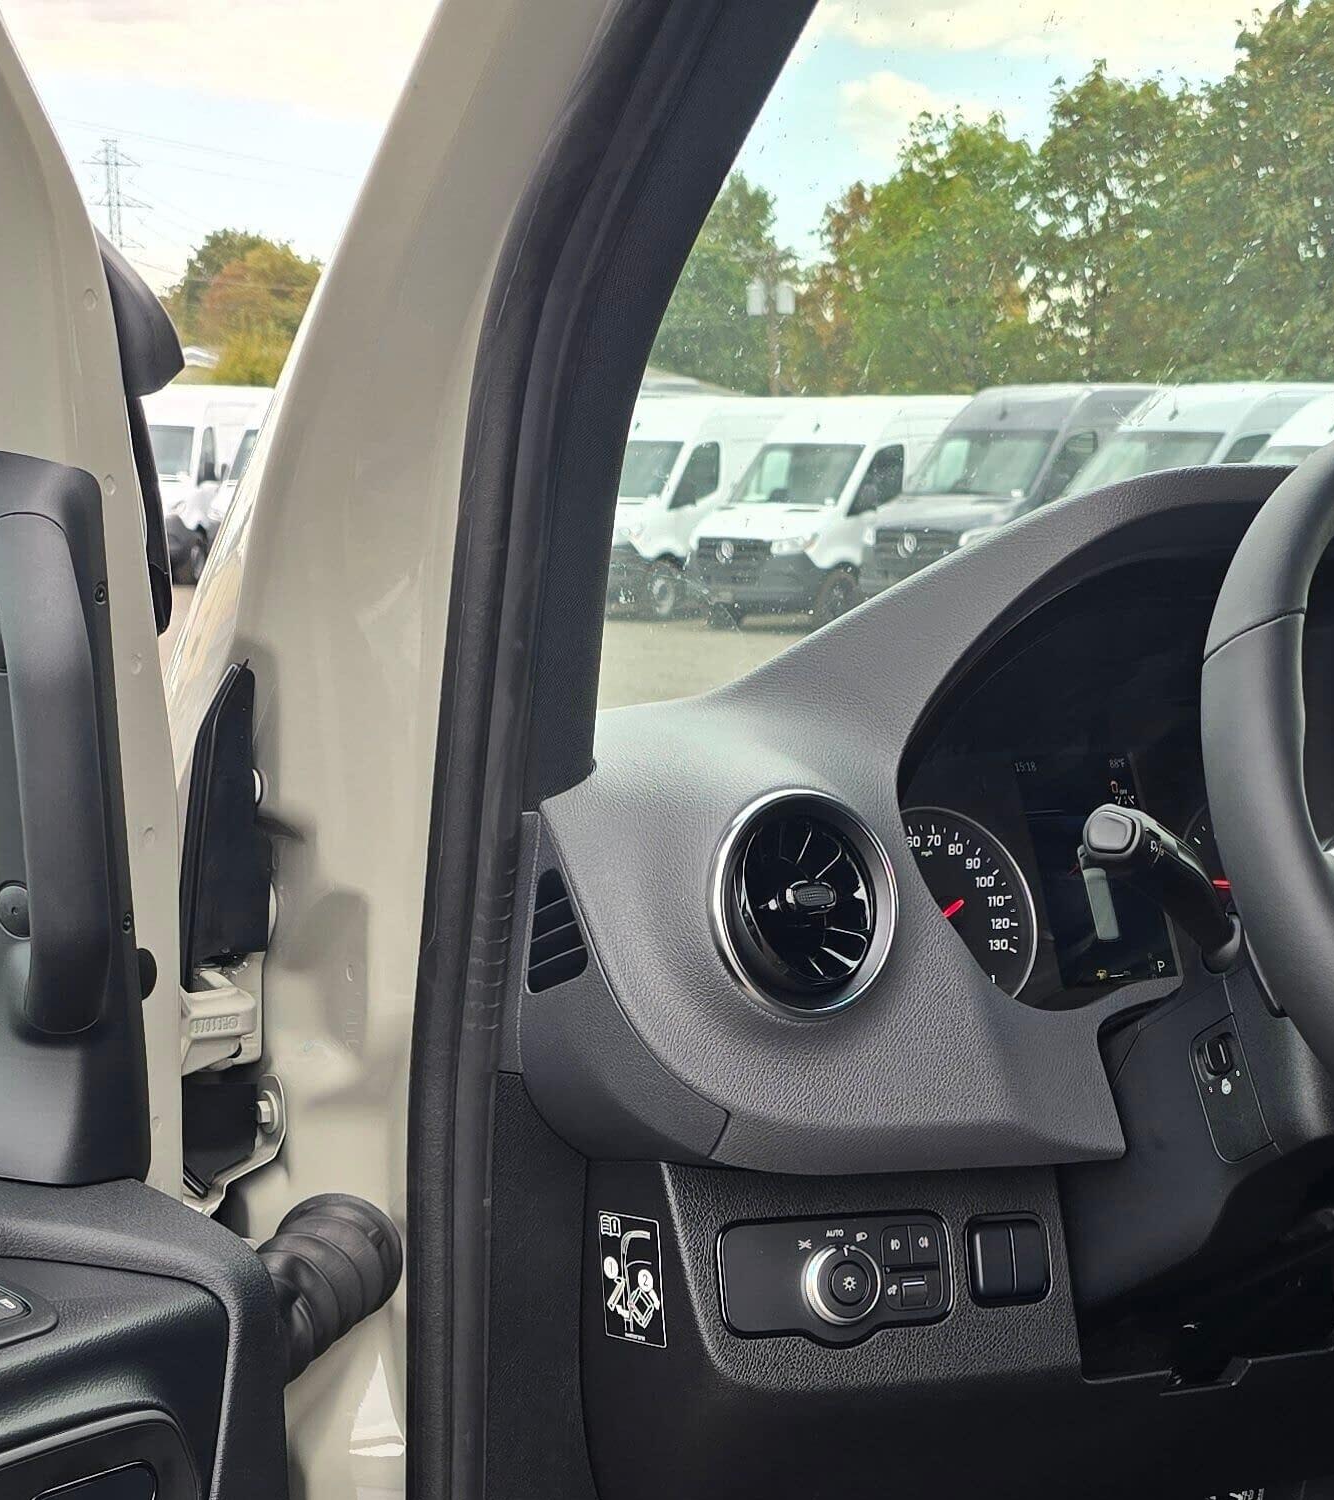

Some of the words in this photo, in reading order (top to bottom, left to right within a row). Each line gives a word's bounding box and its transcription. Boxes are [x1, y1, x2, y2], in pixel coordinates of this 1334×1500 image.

[927, 835, 942, 847] 70
[948, 843, 963, 856] 80
[965, 857, 981, 870] 90
[975, 876, 995, 888] 100
[987, 895, 1005, 907] 110
[991, 918, 1010, 930] 120
[988, 939, 1009, 951] 130
[1157, 960, 1166, 973] P
[826, 1229, 845, 1238] AUTO
